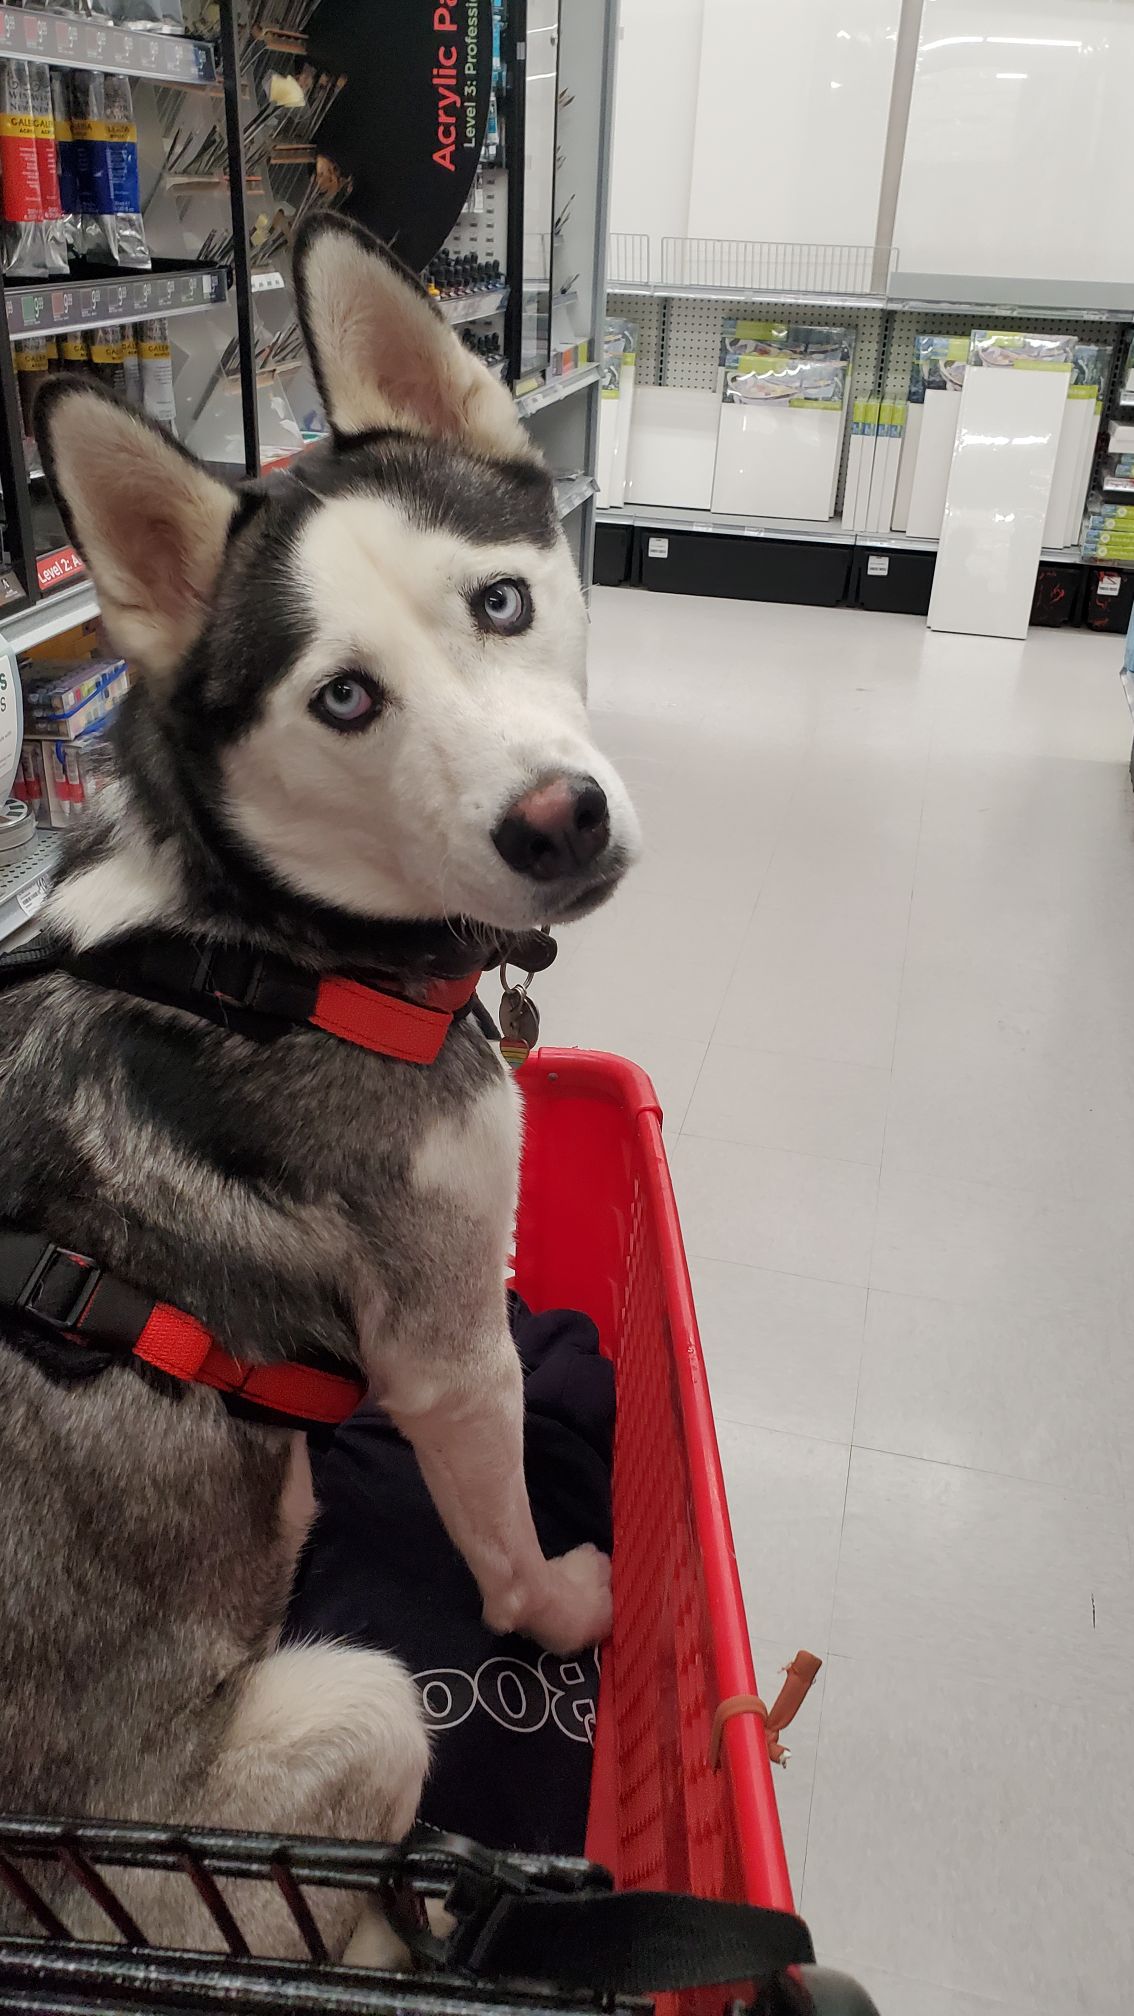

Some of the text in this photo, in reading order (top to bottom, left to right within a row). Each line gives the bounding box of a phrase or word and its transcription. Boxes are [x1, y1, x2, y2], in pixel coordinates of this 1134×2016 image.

[464, 80, 476, 97] 3:
[432, 46, 461, 172] Acrylic
[463, 103, 475, 148] Level
[38, 561, 63, 584] Level
[61, 558, 72, 572] 2:
